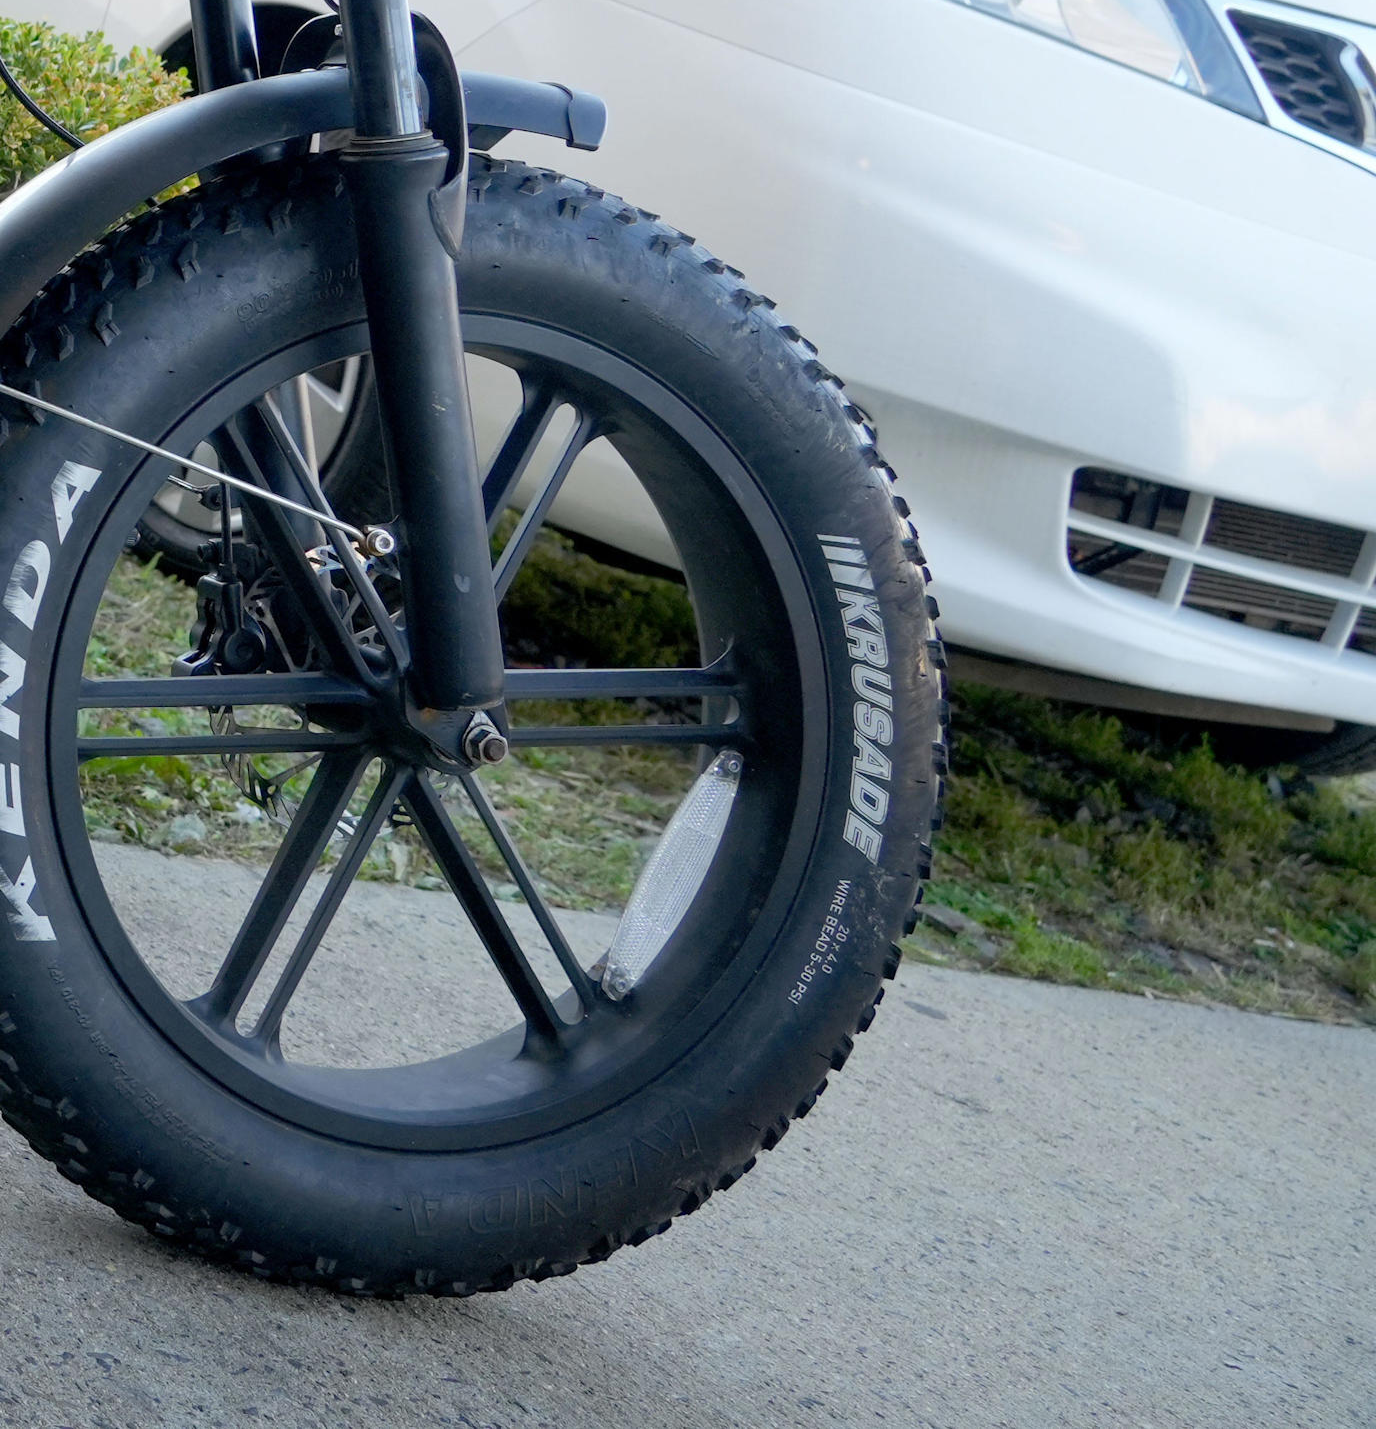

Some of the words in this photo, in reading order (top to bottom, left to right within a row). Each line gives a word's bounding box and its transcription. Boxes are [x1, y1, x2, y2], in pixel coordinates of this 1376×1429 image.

[835, 584, 894, 868] KRUSADE
[829, 879, 851, 915] WIRE
[815, 915, 838, 952] BEAD
[836, 924, 850, 942] 20
[800, 952, 822, 982] 5-30
[822, 953, 838, 974] 4.0
[788, 981, 807, 1005] PSI
